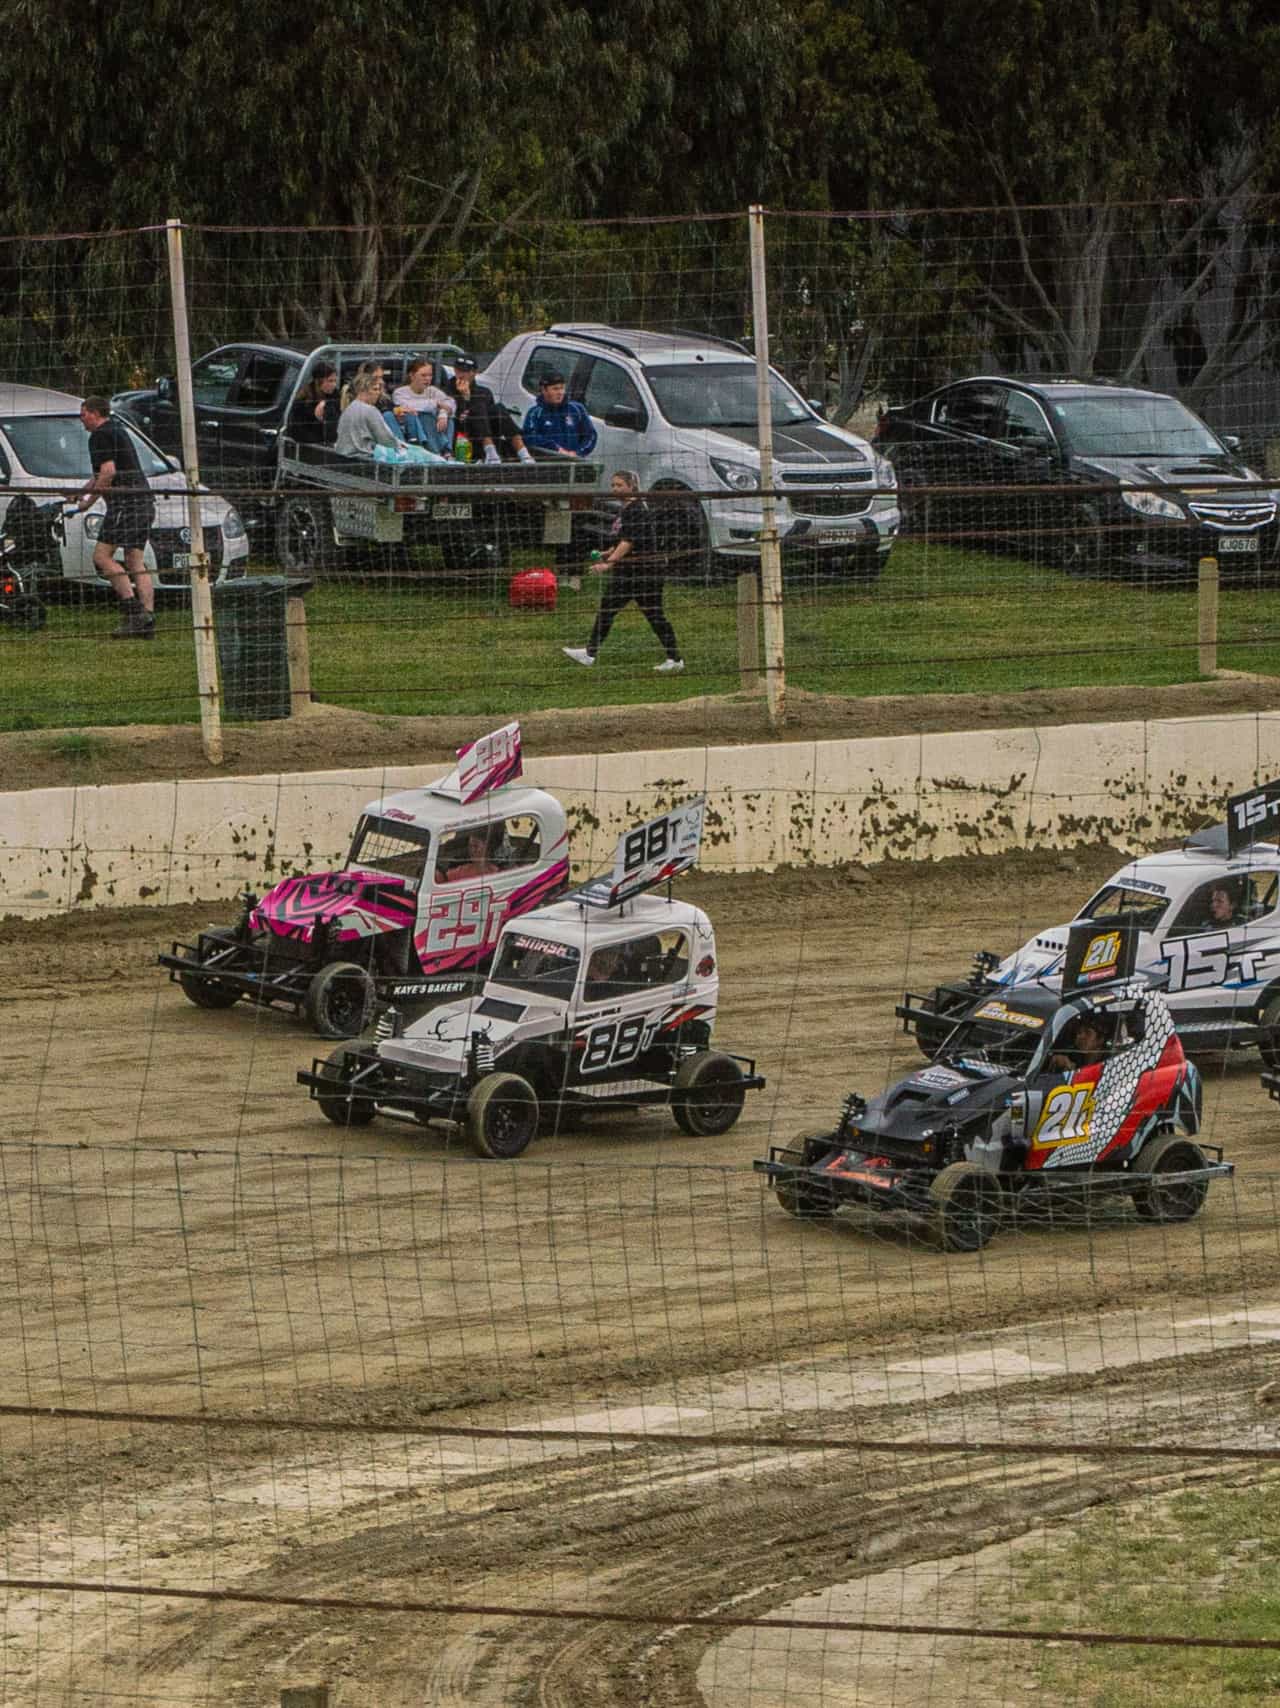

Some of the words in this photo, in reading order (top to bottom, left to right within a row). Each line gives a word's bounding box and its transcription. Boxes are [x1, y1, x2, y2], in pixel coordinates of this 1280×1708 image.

[475, 730, 520, 773] 29T
[624, 816, 683, 873] 88T
[425, 886, 508, 953] 29T
[427, 983, 466, 993] BAKERY
[1159, 931, 1266, 994] 15T
[580, 1015, 660, 1073] 88T
